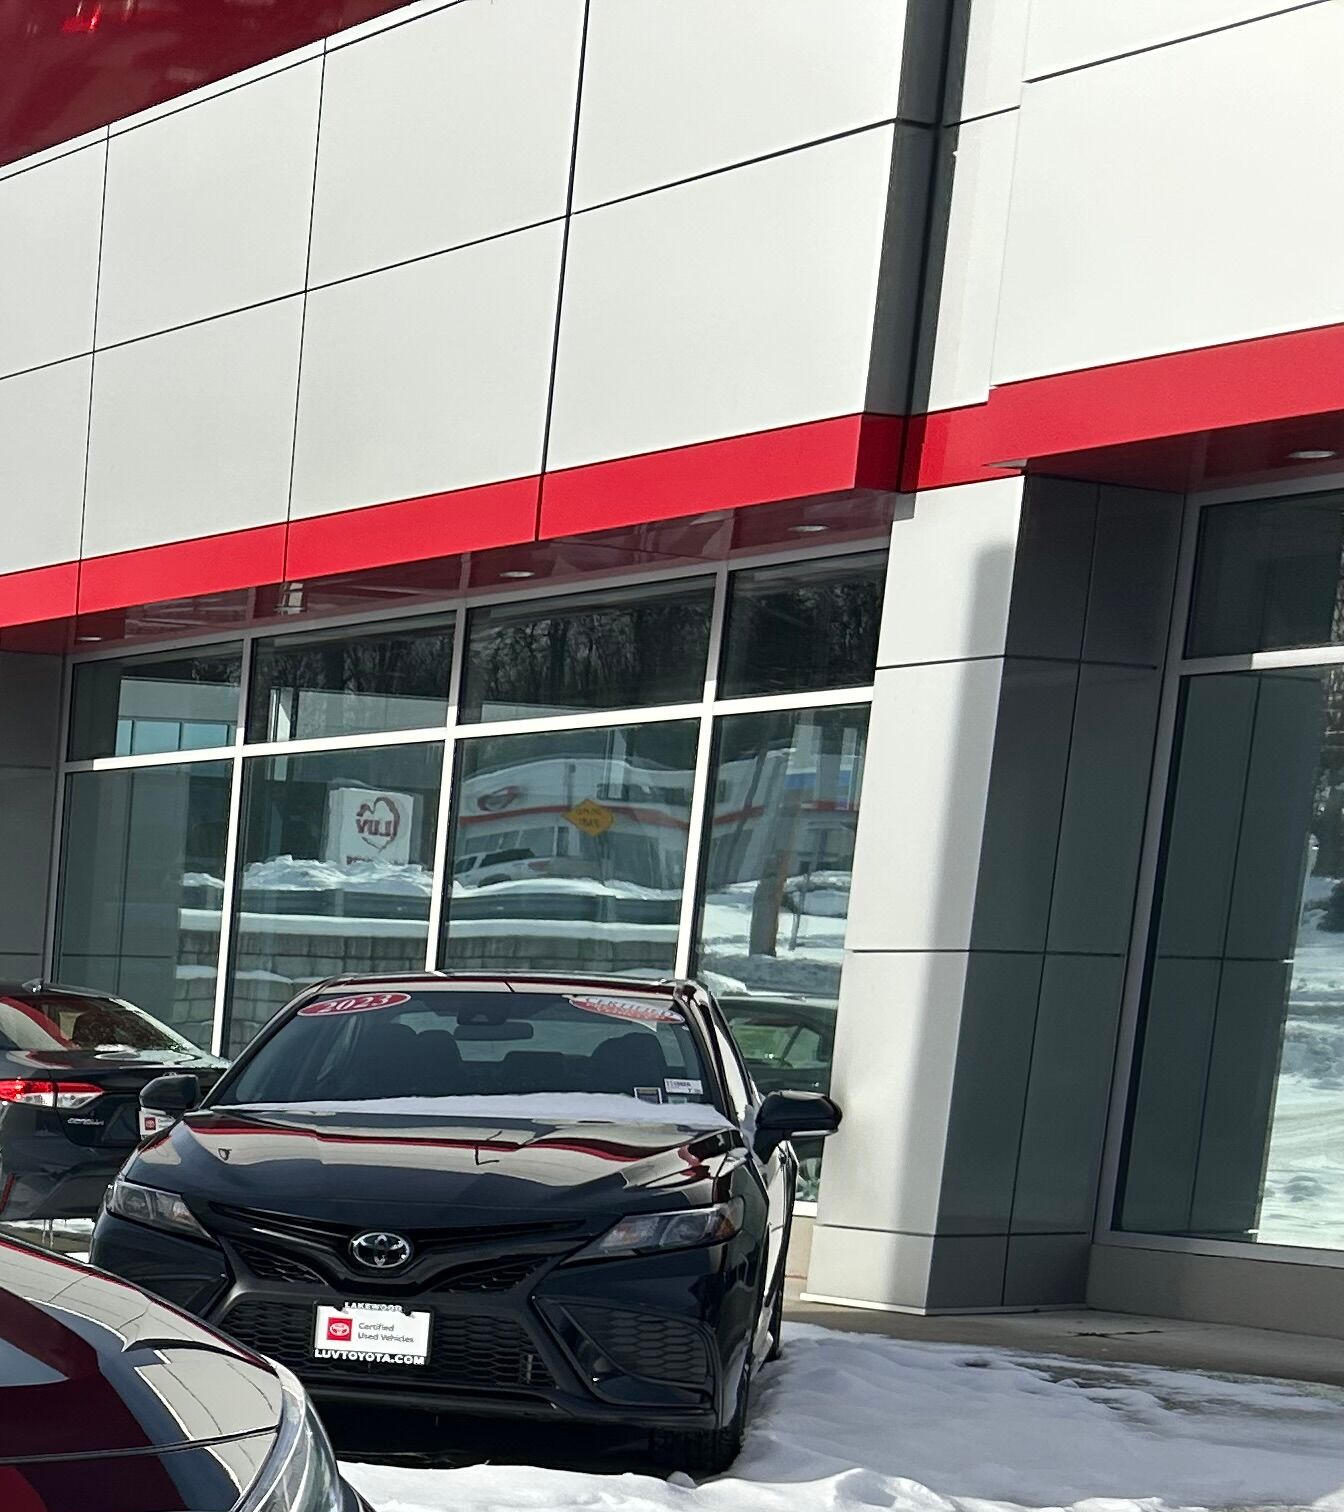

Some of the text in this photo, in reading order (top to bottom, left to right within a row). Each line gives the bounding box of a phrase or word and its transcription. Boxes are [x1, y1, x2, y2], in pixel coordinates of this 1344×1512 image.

[317, 994, 392, 1013] 2023
[344, 1301, 403, 1312] LAKEWOOD
[358, 1322, 394, 1332] Certified
[357, 1332, 415, 1344] Used Vehicles
[314, 1348, 425, 1366] LUVTOYOTA.COM
